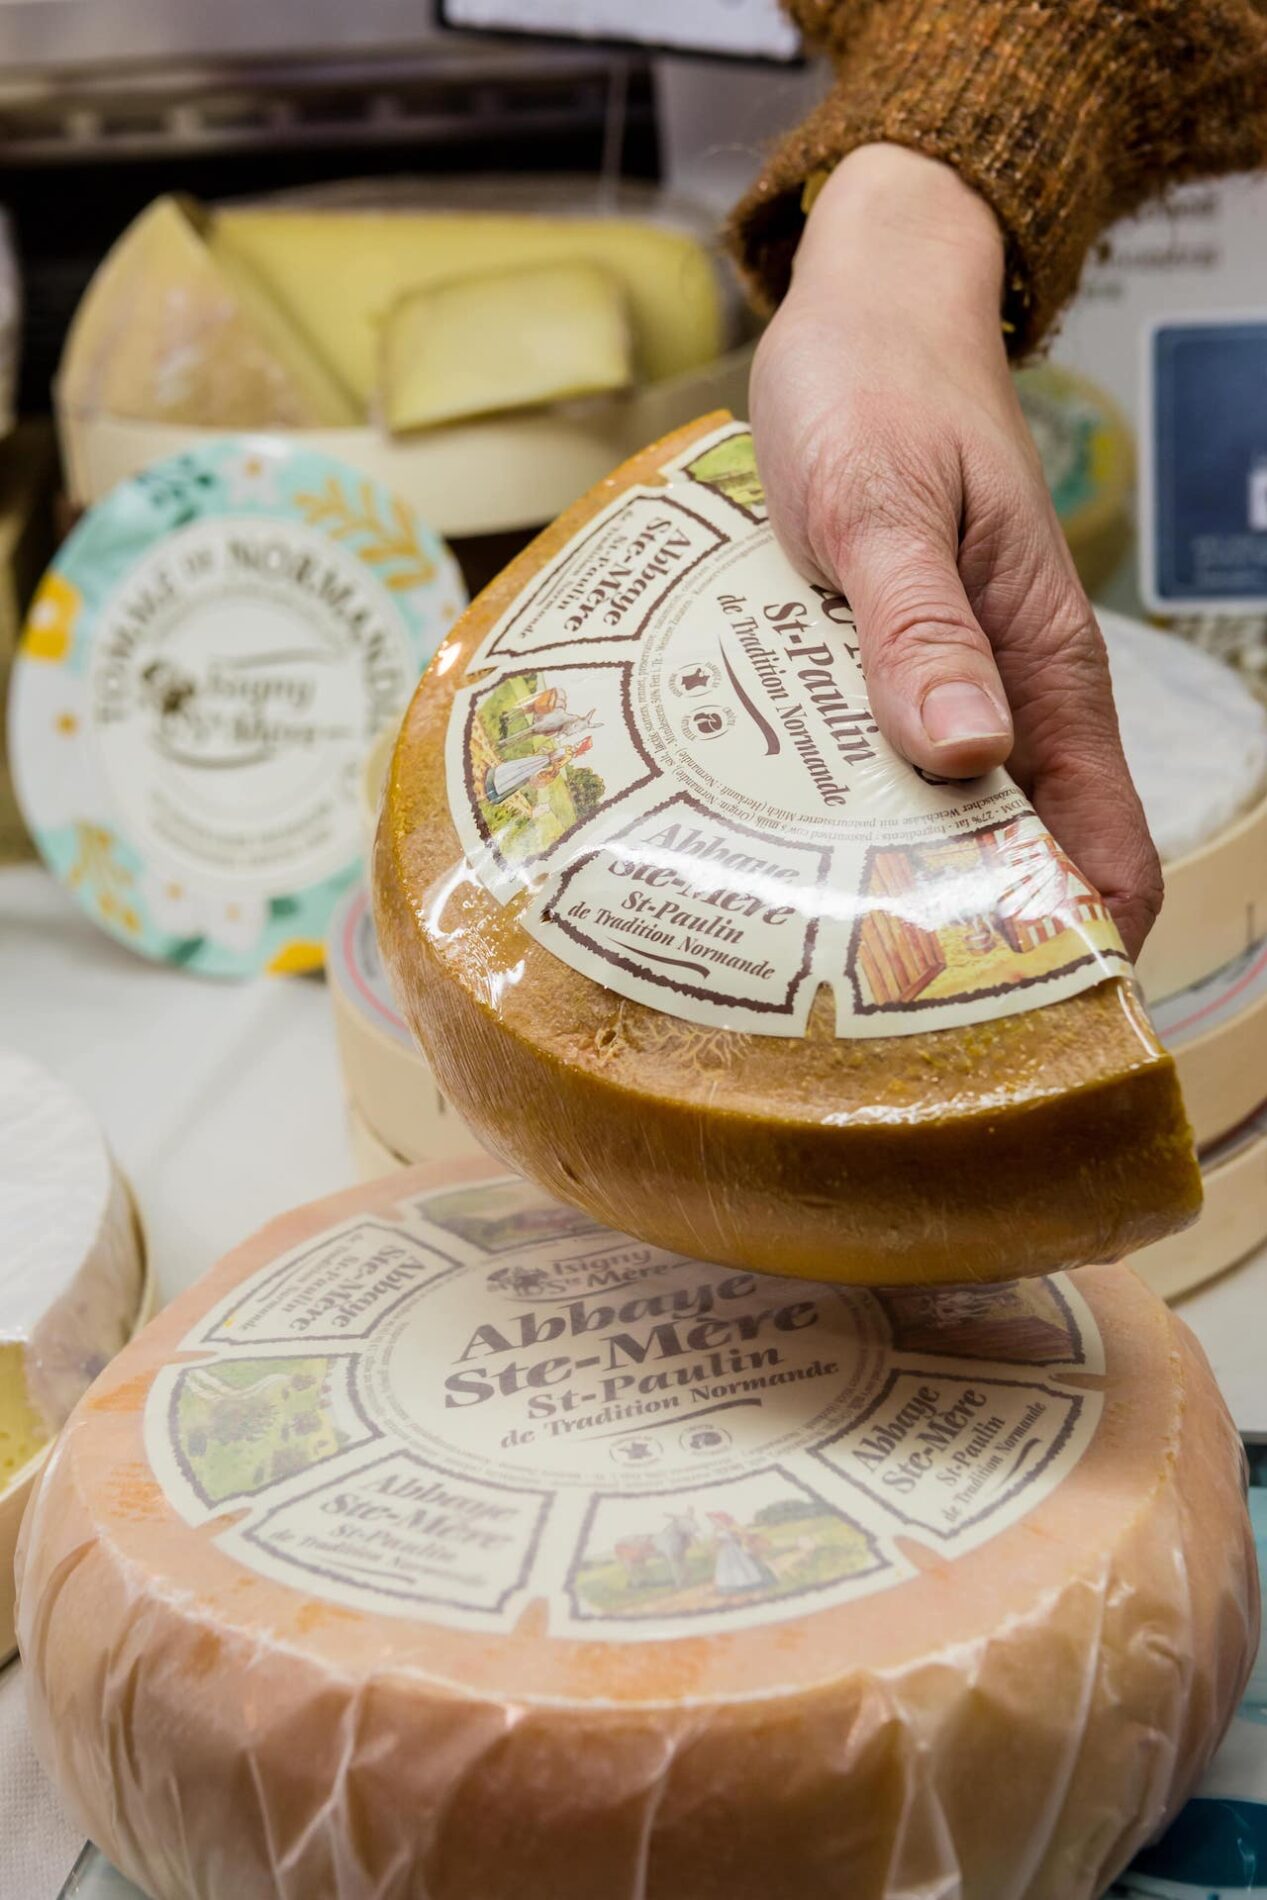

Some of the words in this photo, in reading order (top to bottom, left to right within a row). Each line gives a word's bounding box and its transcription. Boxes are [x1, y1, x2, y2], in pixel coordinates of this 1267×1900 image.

[557, 536, 628, 610] St-Paulin
[563, 517, 672, 632] Ste-Mère
[603, 528, 691, 626] Abbaye
[716, 594, 747, 615] de
[730, 616, 789, 701] Tradition
[762, 601, 880, 766] St-Paulin
[650, 732, 667, 754] lactic
[775, 703, 851, 807] Normande
[757, 815, 781, 830] milk
[768, 805, 797, 822] Milch
[882, 826, 947, 841] Ingredients
[903, 807, 960, 826] Weichkäse
[955, 818, 971, 830] fat
[970, 810, 995, 825] 27%
[1002, 798, 1026, 813] IDM
[568, 902, 590, 919] de
[594, 907, 675, 946] Tradition
[677, 936, 776, 980] Normande
[620, 890, 745, 945] St-Paulin
[331, 1255, 427, 1328] Abbaye
[553, 1249, 652, 1275] Isigny
[587, 1264, 668, 1288] Mère
[443, 1300, 820, 1410] Ste-Mère
[450, 1273, 758, 1365] Abbaye
[501, 1427, 536, 1451] de
[542, 1397, 681, 1439] Tradition
[687, 1359, 840, 1404] Normande
[527, 1343, 786, 1420] St-Paulin
[852, 1385, 940, 1474] Abbaye
[881, 1387, 987, 1495] Ste-Mère
[935, 1415, 1006, 1487] St-Paulin
[956, 1452, 1004, 1505] Tradition
[994, 1400, 1047, 1460] Normande
[360, 1473, 522, 1523] Abbaye
